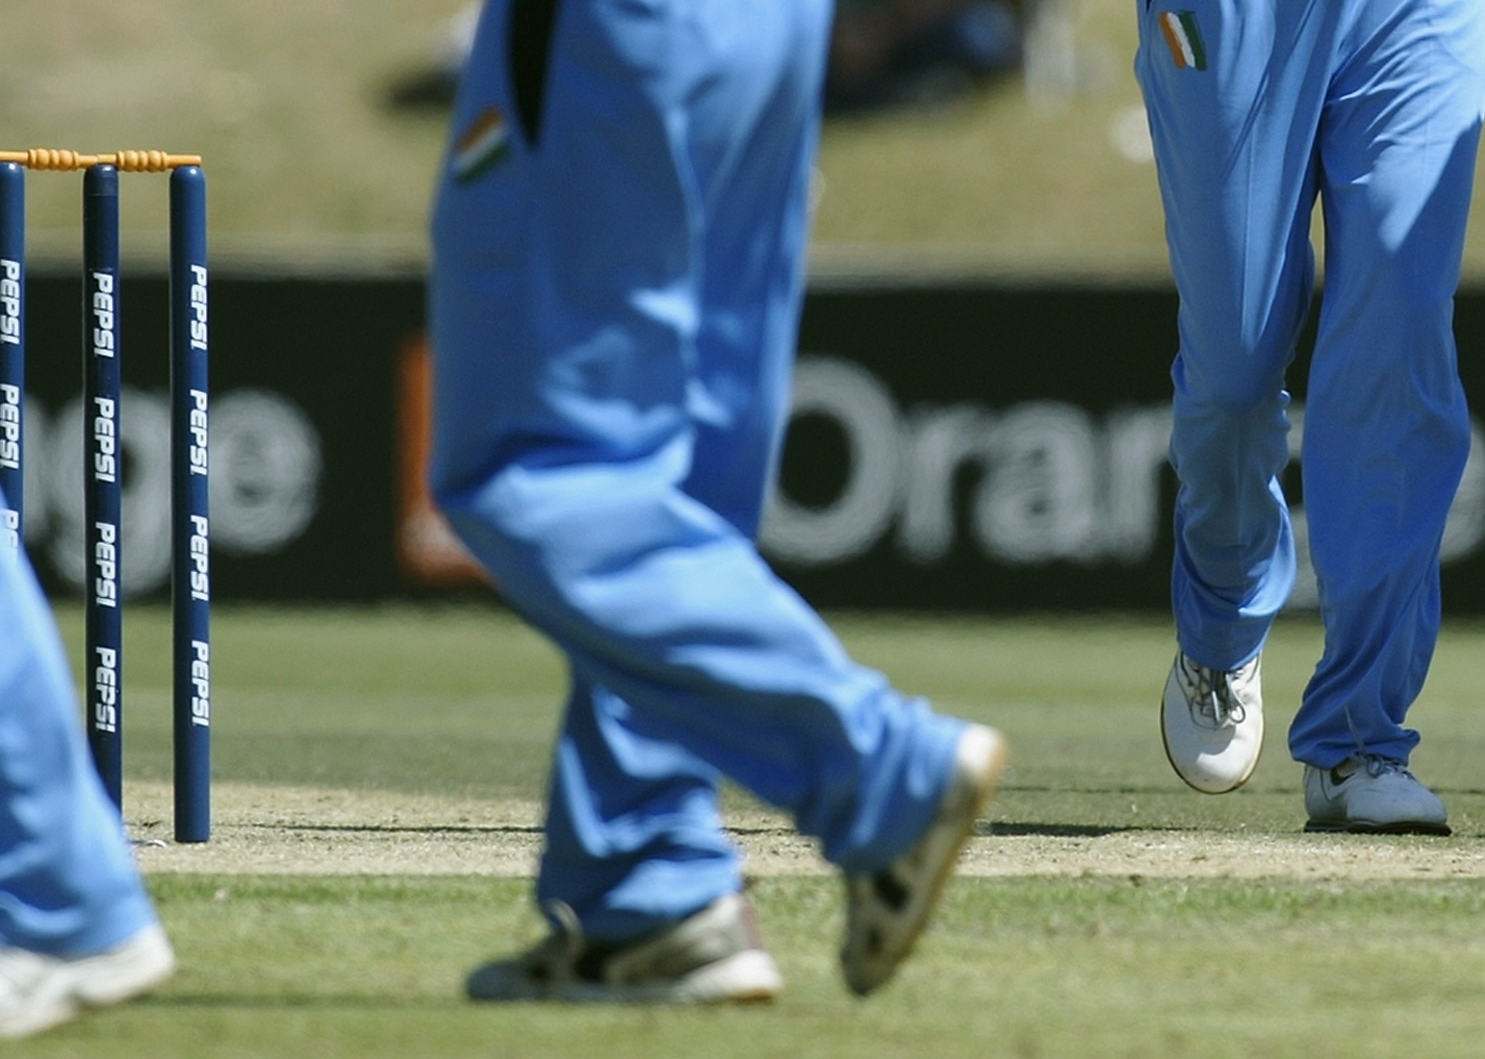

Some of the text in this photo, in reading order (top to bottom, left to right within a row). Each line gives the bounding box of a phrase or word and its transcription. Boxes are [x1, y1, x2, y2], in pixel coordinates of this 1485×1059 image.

[0, 259, 20, 344] PEPSI
[93, 272, 114, 358] PEPSI
[190, 264, 208, 350] PEPSI
[0, 383, 20, 469] PEPSI
[94, 396, 115, 483] PEPSI
[190, 389, 208, 476] PEPSI
[95, 521, 116, 608] PEPSI
[190, 515, 209, 601] PEPSI
[95, 646, 116, 733] PEPSI
[190, 639, 210, 727] PEPSI
